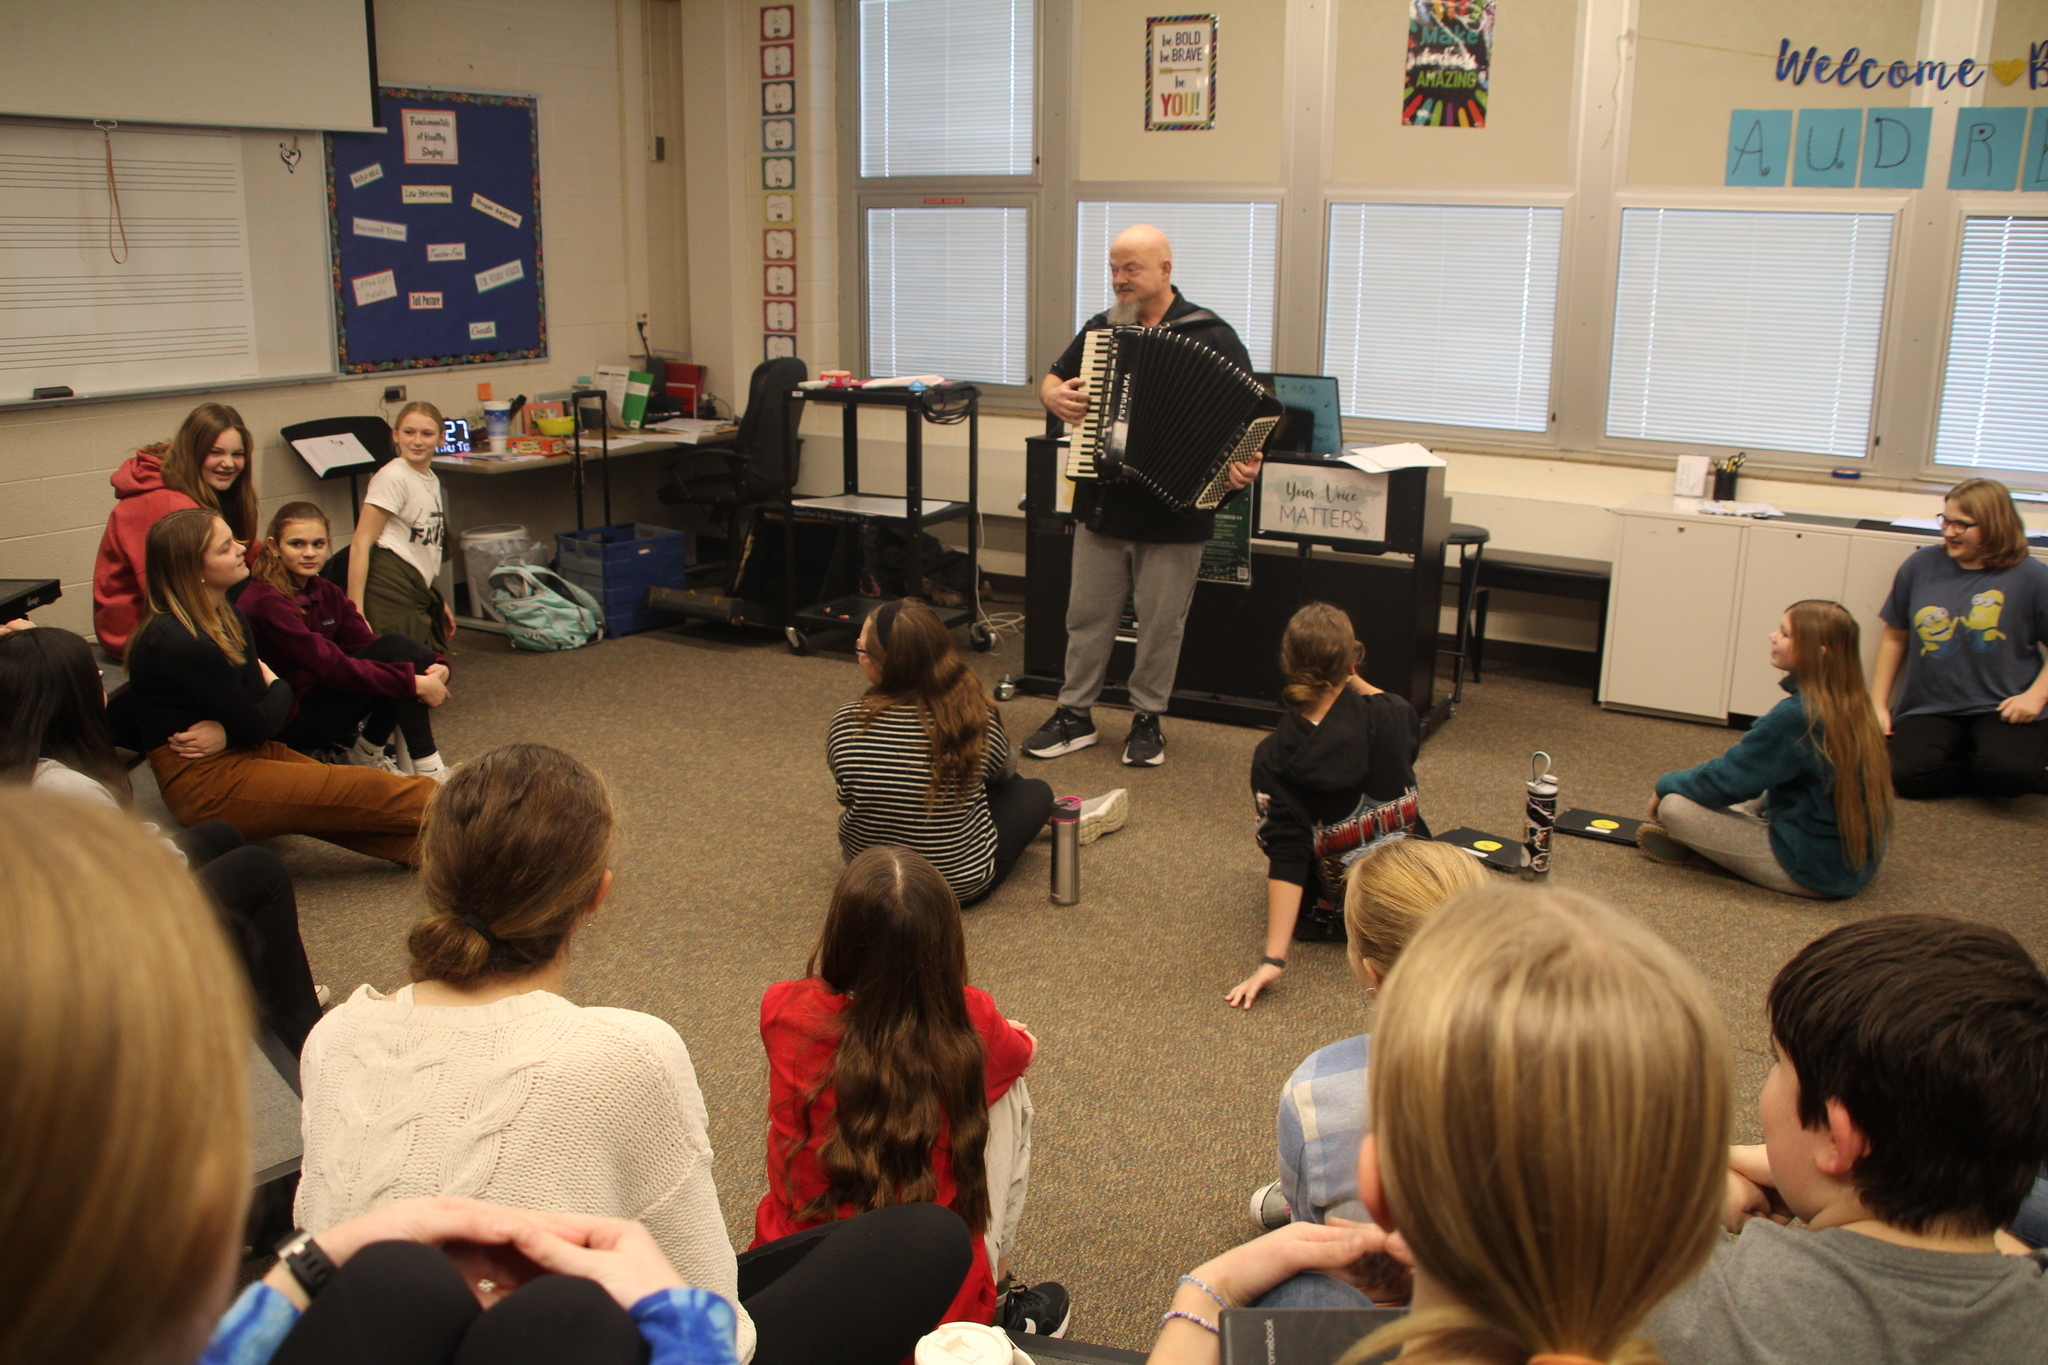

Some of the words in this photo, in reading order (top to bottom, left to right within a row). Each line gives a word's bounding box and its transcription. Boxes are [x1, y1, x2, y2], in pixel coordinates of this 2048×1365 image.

[1162, 33, 1173, 47] be
[1175, 31, 1201, 46] BOLD
[1160, 50, 1170, 63] be
[1172, 47, 1203, 62] BRAVE
[1776, 38, 1985, 90] Welcome
[1175, 75, 1185, 88] be
[1416, 71, 1477, 88] AMAZING
[1161, 91, 1201, 117] YOU!
[355, 223, 384, 234] Focused
[1117, 372, 1131, 421] FUTURAMA
[443, 420, 469, 442] 27
[1286, 481, 1315, 501] Your
[1326, 483, 1358, 503] Voice
[1280, 505, 1363, 530] MATTERS
[1264, 1318, 1276, 1365] omebook
